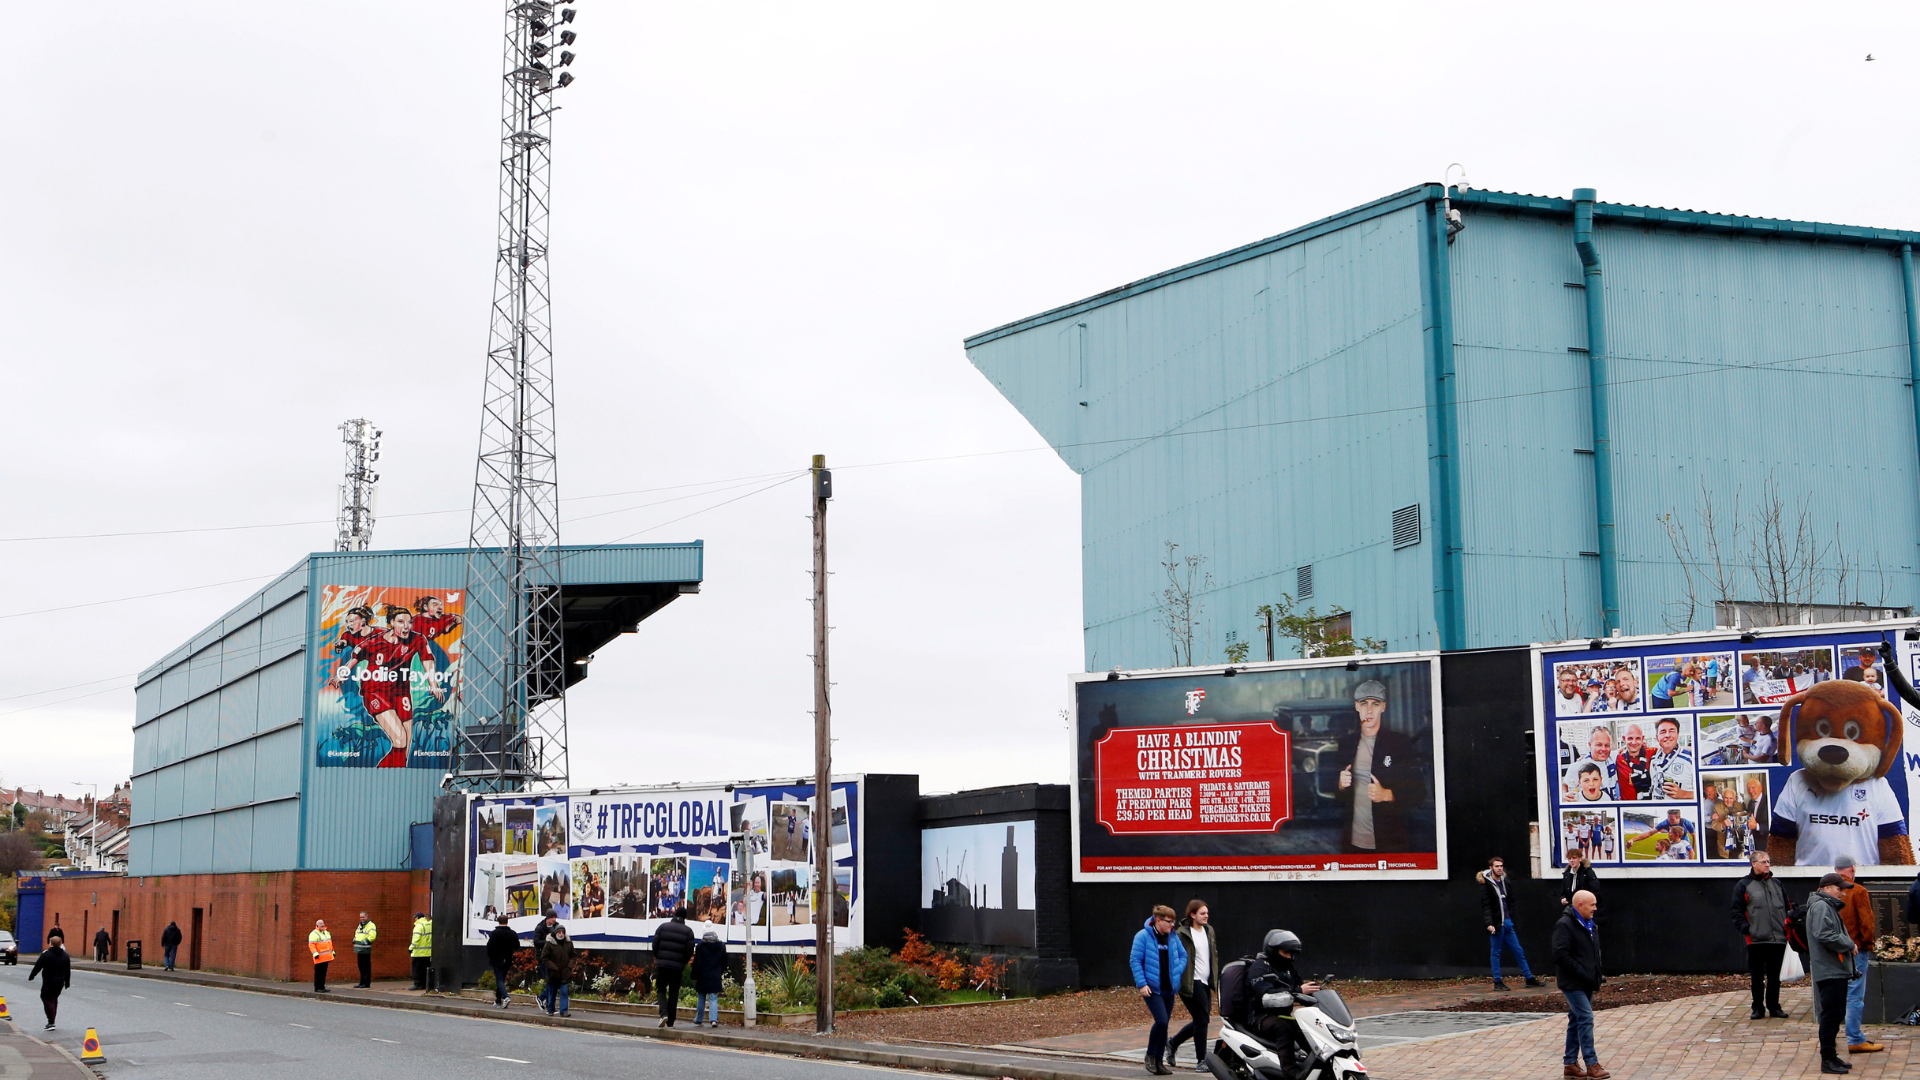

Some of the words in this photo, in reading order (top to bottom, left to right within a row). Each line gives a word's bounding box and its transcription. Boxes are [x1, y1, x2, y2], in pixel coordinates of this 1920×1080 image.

[376, 652, 384, 666] 9
[402, 696, 411, 712] 9
[1137, 733, 1170, 748] HAVE
[1174, 733, 1182, 747] A
[1137, 746, 1242, 771] CHRISTMAS
[1138, 771, 1160, 780] WITH
[1162, 770, 1207, 780] TRANMERE
[1208, 768, 1242, 778] ROVERS
[1199, 782, 1226, 792] FRIDAYS
[1227, 782, 1233, 790] &
[1234, 781, 1270, 790] SATURDAYS
[1116, 788, 1152, 800] THEMED
[1154, 787, 1192, 798] PARTIES
[1116, 800, 1128, 810] AT
[1129, 798, 1167, 810] PRENTON
[1169, 798, 1192, 809] PARK
[1200, 804, 1238, 814] PURCHASE
[1240, 803, 1271, 813] TICKETS
[597, 800, 728, 839] #TRFCGLOBAL
[1116, 810, 1145, 821] £39.50
[1147, 809, 1166, 820] PER
[1168, 809, 1193, 820] HEAD
[1200, 813, 1272, 824] TRFCTICKETS.CO.UK
[1809, 814, 1860, 826] ESSAR
